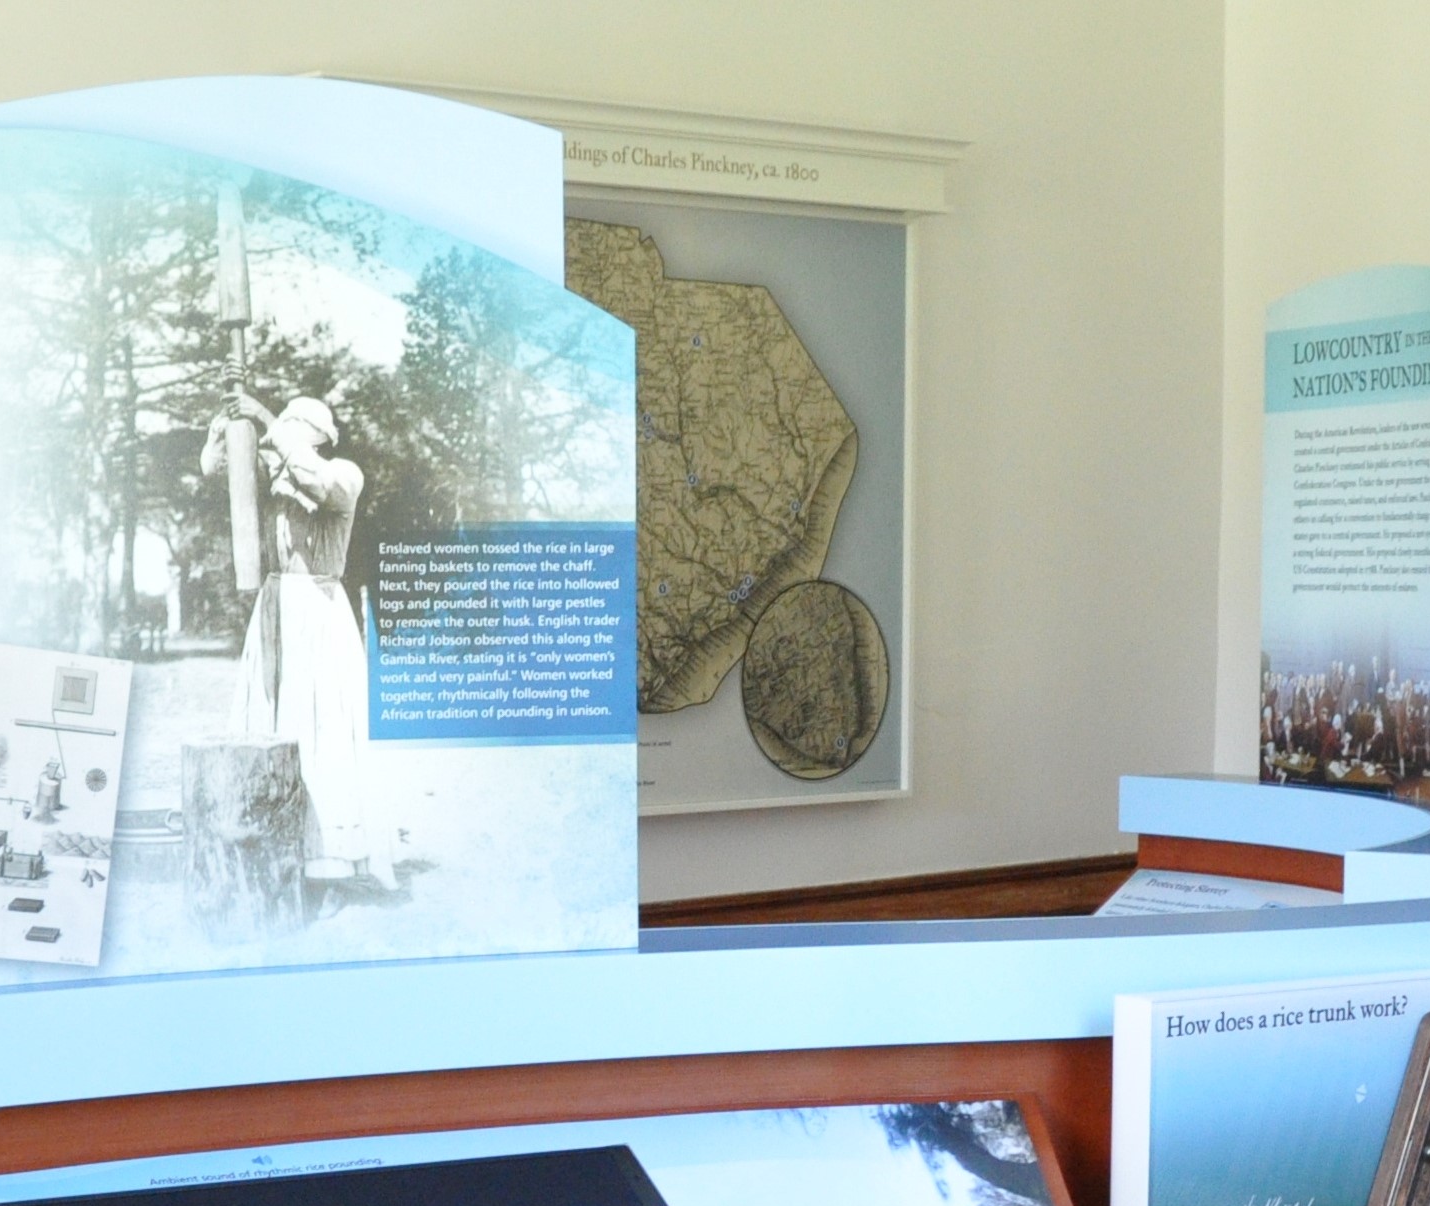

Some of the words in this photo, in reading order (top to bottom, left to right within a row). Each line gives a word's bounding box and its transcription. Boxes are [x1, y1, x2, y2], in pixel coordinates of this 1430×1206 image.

[564, 143, 608, 167] ldings
[612, 147, 630, 164] of
[631, 148, 687, 169] Charles
[691, 152, 759, 181] Pinckney,
[763, 165, 780, 177] ca.
[785, 163, 819, 182] 1800
[1294, 331, 1402, 365] LOWCOUNTRY
[1293, 370, 1367, 398] NATION’S
[379, 542, 431, 554] Enslaved
[434, 545, 479, 554] women
[482, 542, 520, 554] tossed
[523, 542, 543, 554] the
[546, 542, 567, 554] rice
[570, 542, 581, 553] in
[585, 542, 614, 556] large
[381, 708, 423, 720] African
[427, 708, 478, 719] tradition
[481, 706, 494, 718] of
[497, 706, 553, 720] pounding
[557, 705, 568, 716] in
[571, 704, 612, 716] unison.
[1167, 1016, 1211, 1038] How
[1215, 1012, 1254, 1033] does
[1259, 1015, 1267, 1029] a
[1273, 1006, 1303, 1028] rice
[1309, 1000, 1356, 1024] trunk
[1361, 996, 1407, 1018] work?
